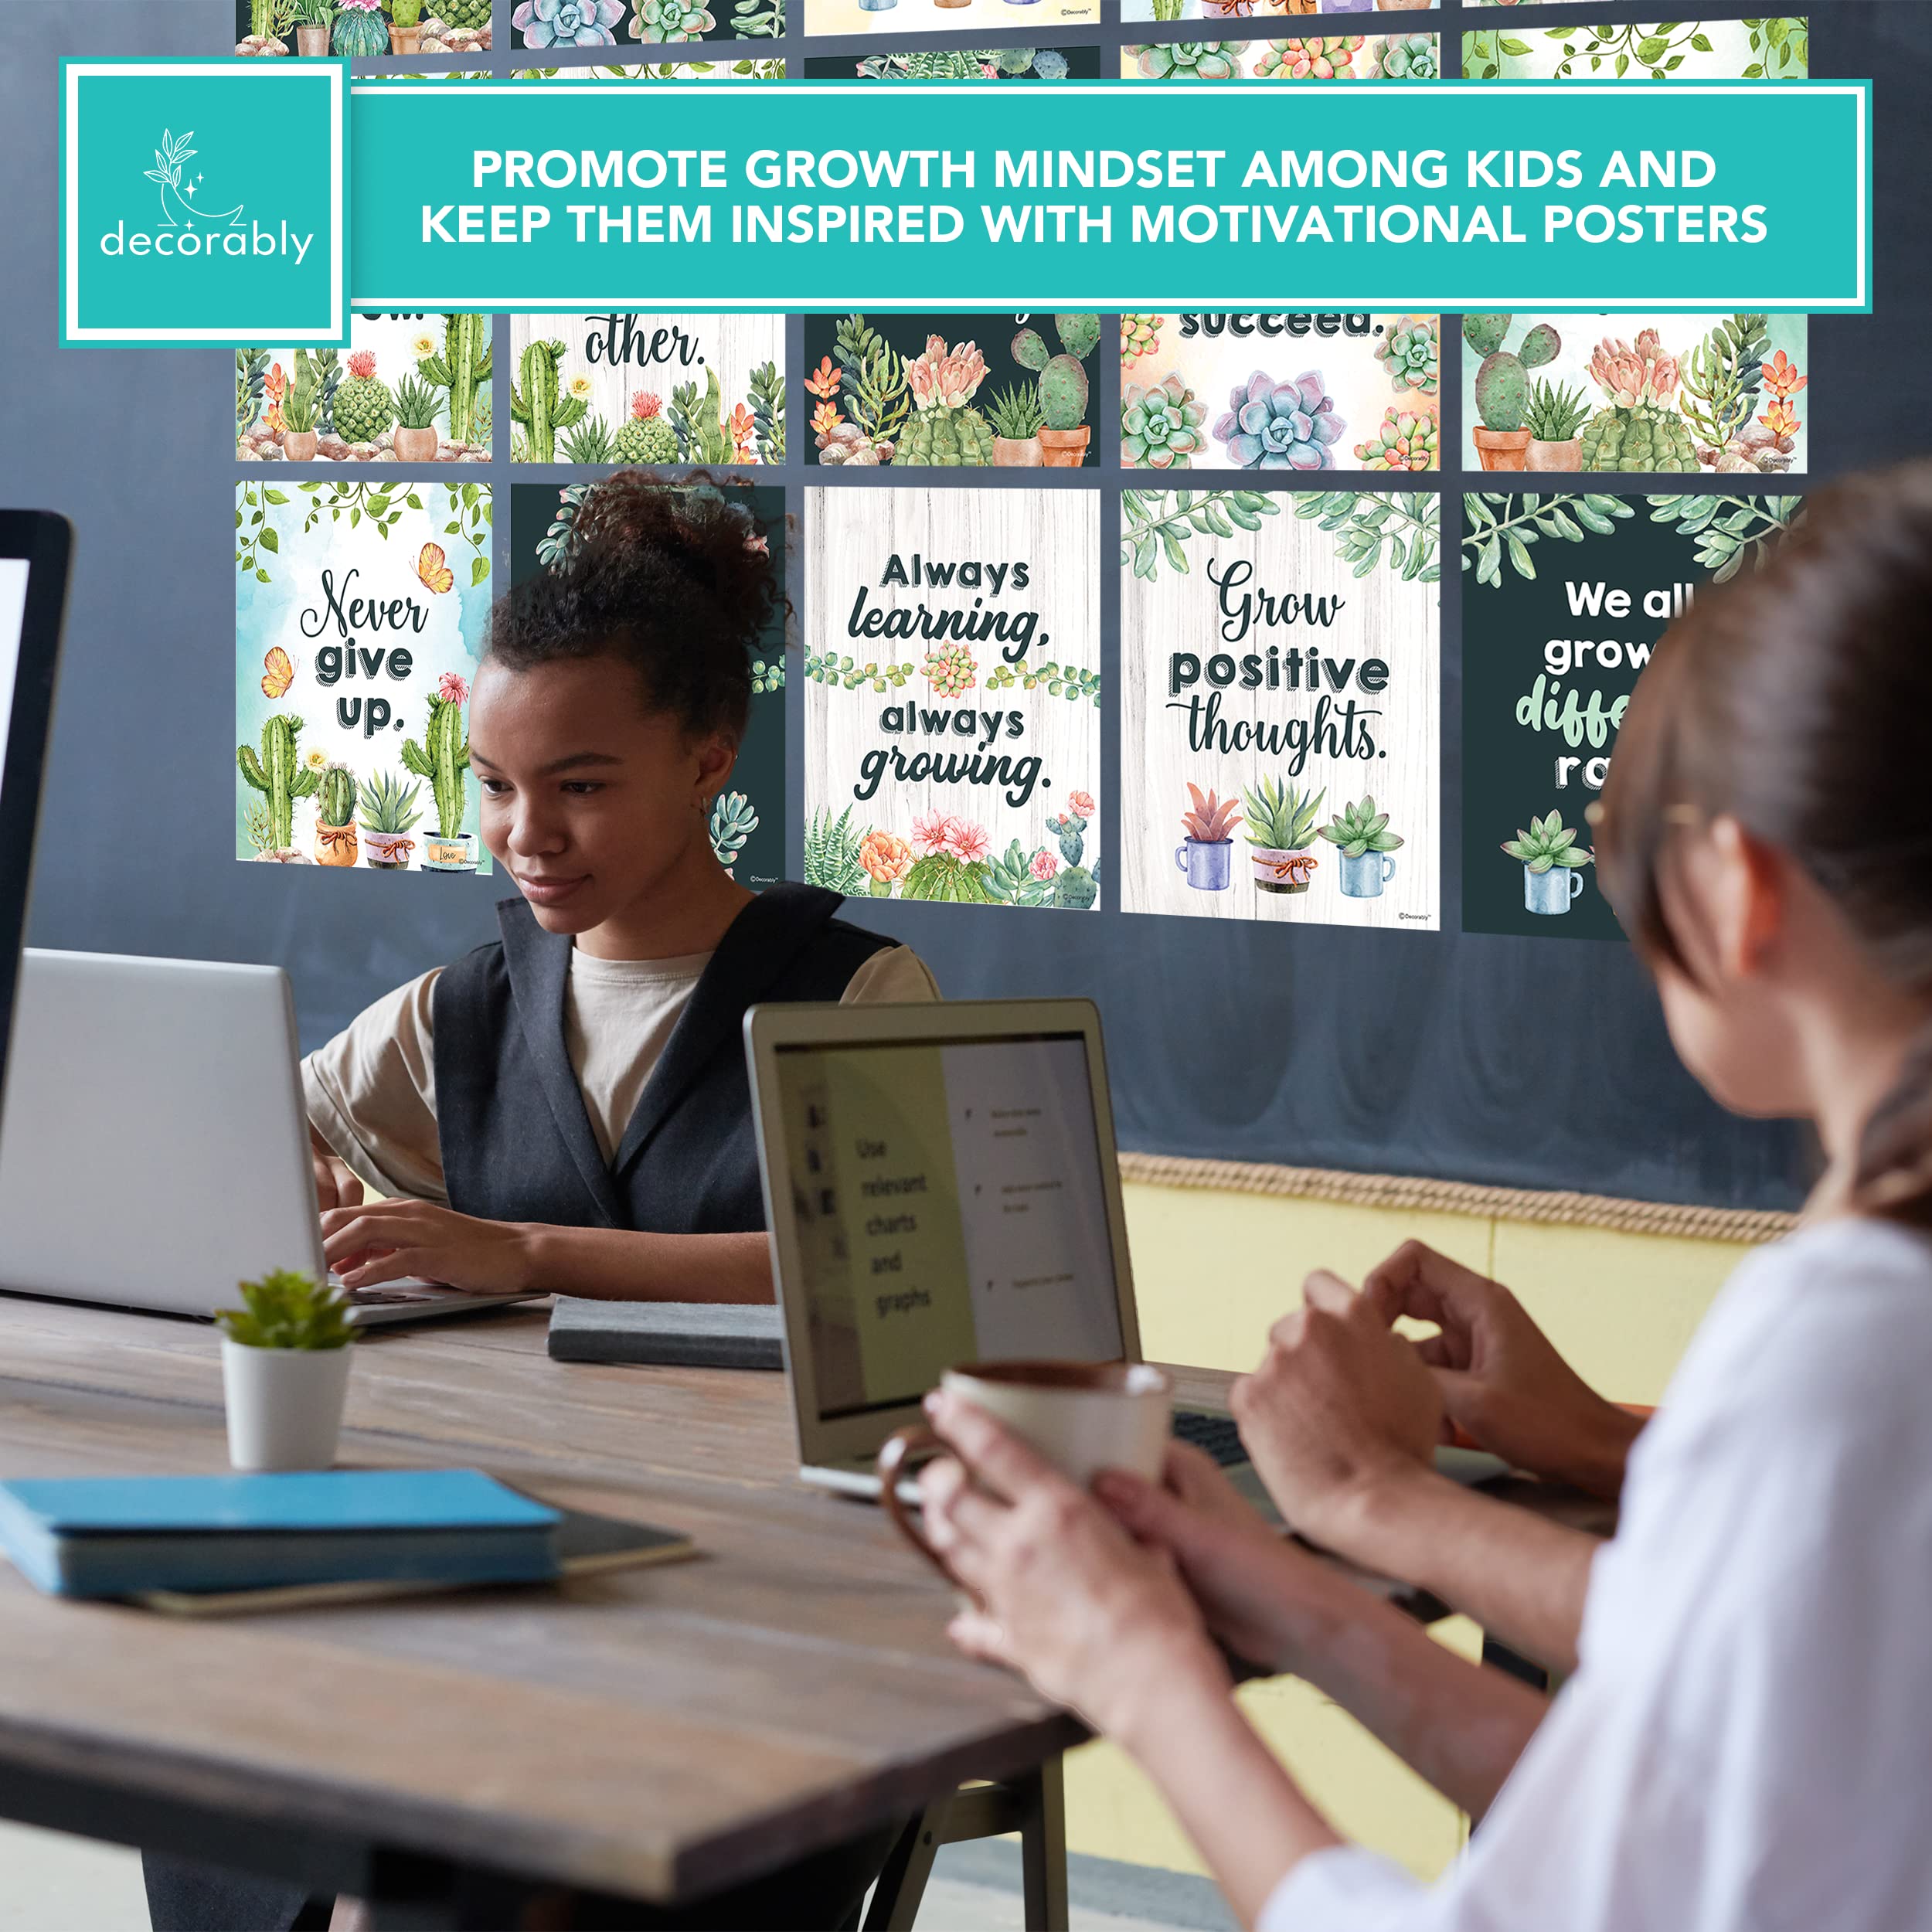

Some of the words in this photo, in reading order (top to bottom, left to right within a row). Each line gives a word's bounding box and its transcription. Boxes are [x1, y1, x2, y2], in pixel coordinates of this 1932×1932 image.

[585, 314, 705, 367] other.
[879, 554, 1030, 598] Always
[301, 568, 429, 638] Never
[1206, 557, 1345, 642] Grow
[1564, 581, 1631, 618] We
[1643, 582, 1695, 618] all
[848, 586, 1049, 663] learning,
[315, 638, 413, 688] give
[1168, 645, 1390, 697] positive
[336, 697, 405, 740] up.
[879, 701, 1026, 746] always
[1165, 692, 1386, 777] thoughts.
[853, 741, 1052, 808] growing.
[855, 1138, 886, 1159] Use
[861, 1174, 927, 1198] relevant
[866, 1213, 917, 1236] charts
[871, 1250, 903, 1274] and
[876, 1286, 931, 1318] graphs
